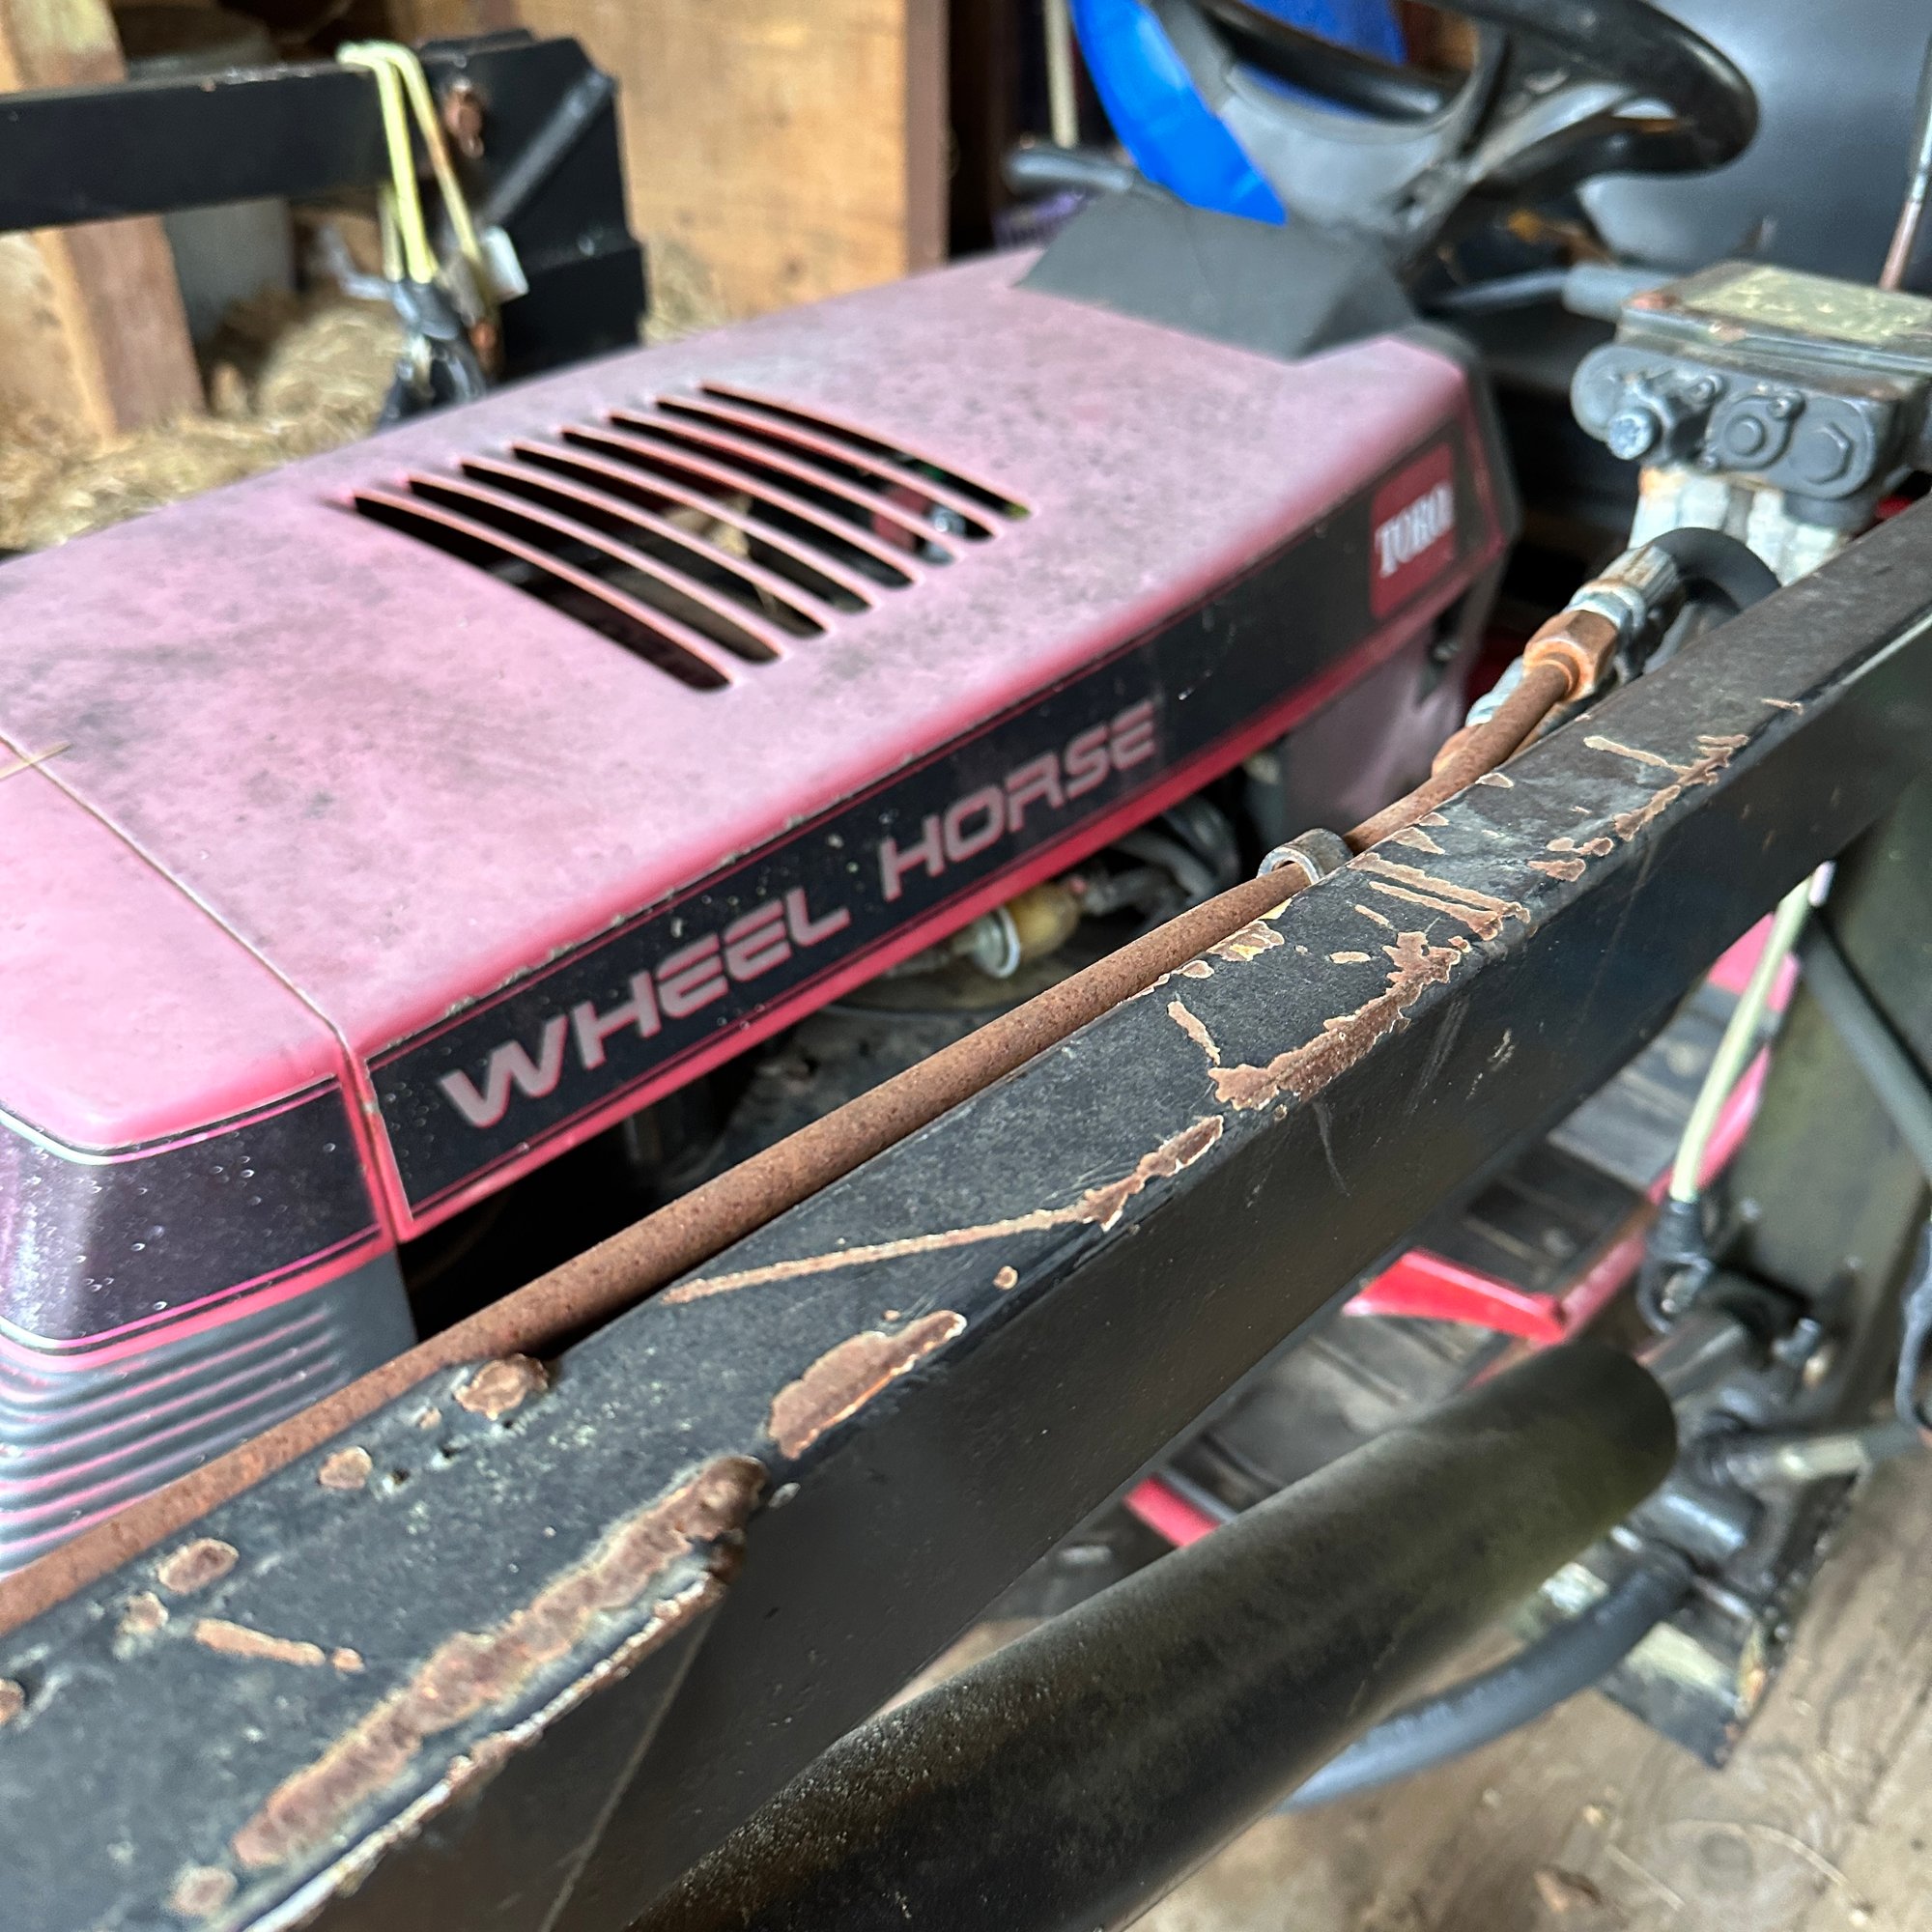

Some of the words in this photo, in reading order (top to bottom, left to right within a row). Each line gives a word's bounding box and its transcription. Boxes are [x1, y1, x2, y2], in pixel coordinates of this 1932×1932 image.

[1374, 481, 1454, 578] TORO
[439, 889, 850, 1128] WHEEL
[878, 701, 1156, 902] HORSE
